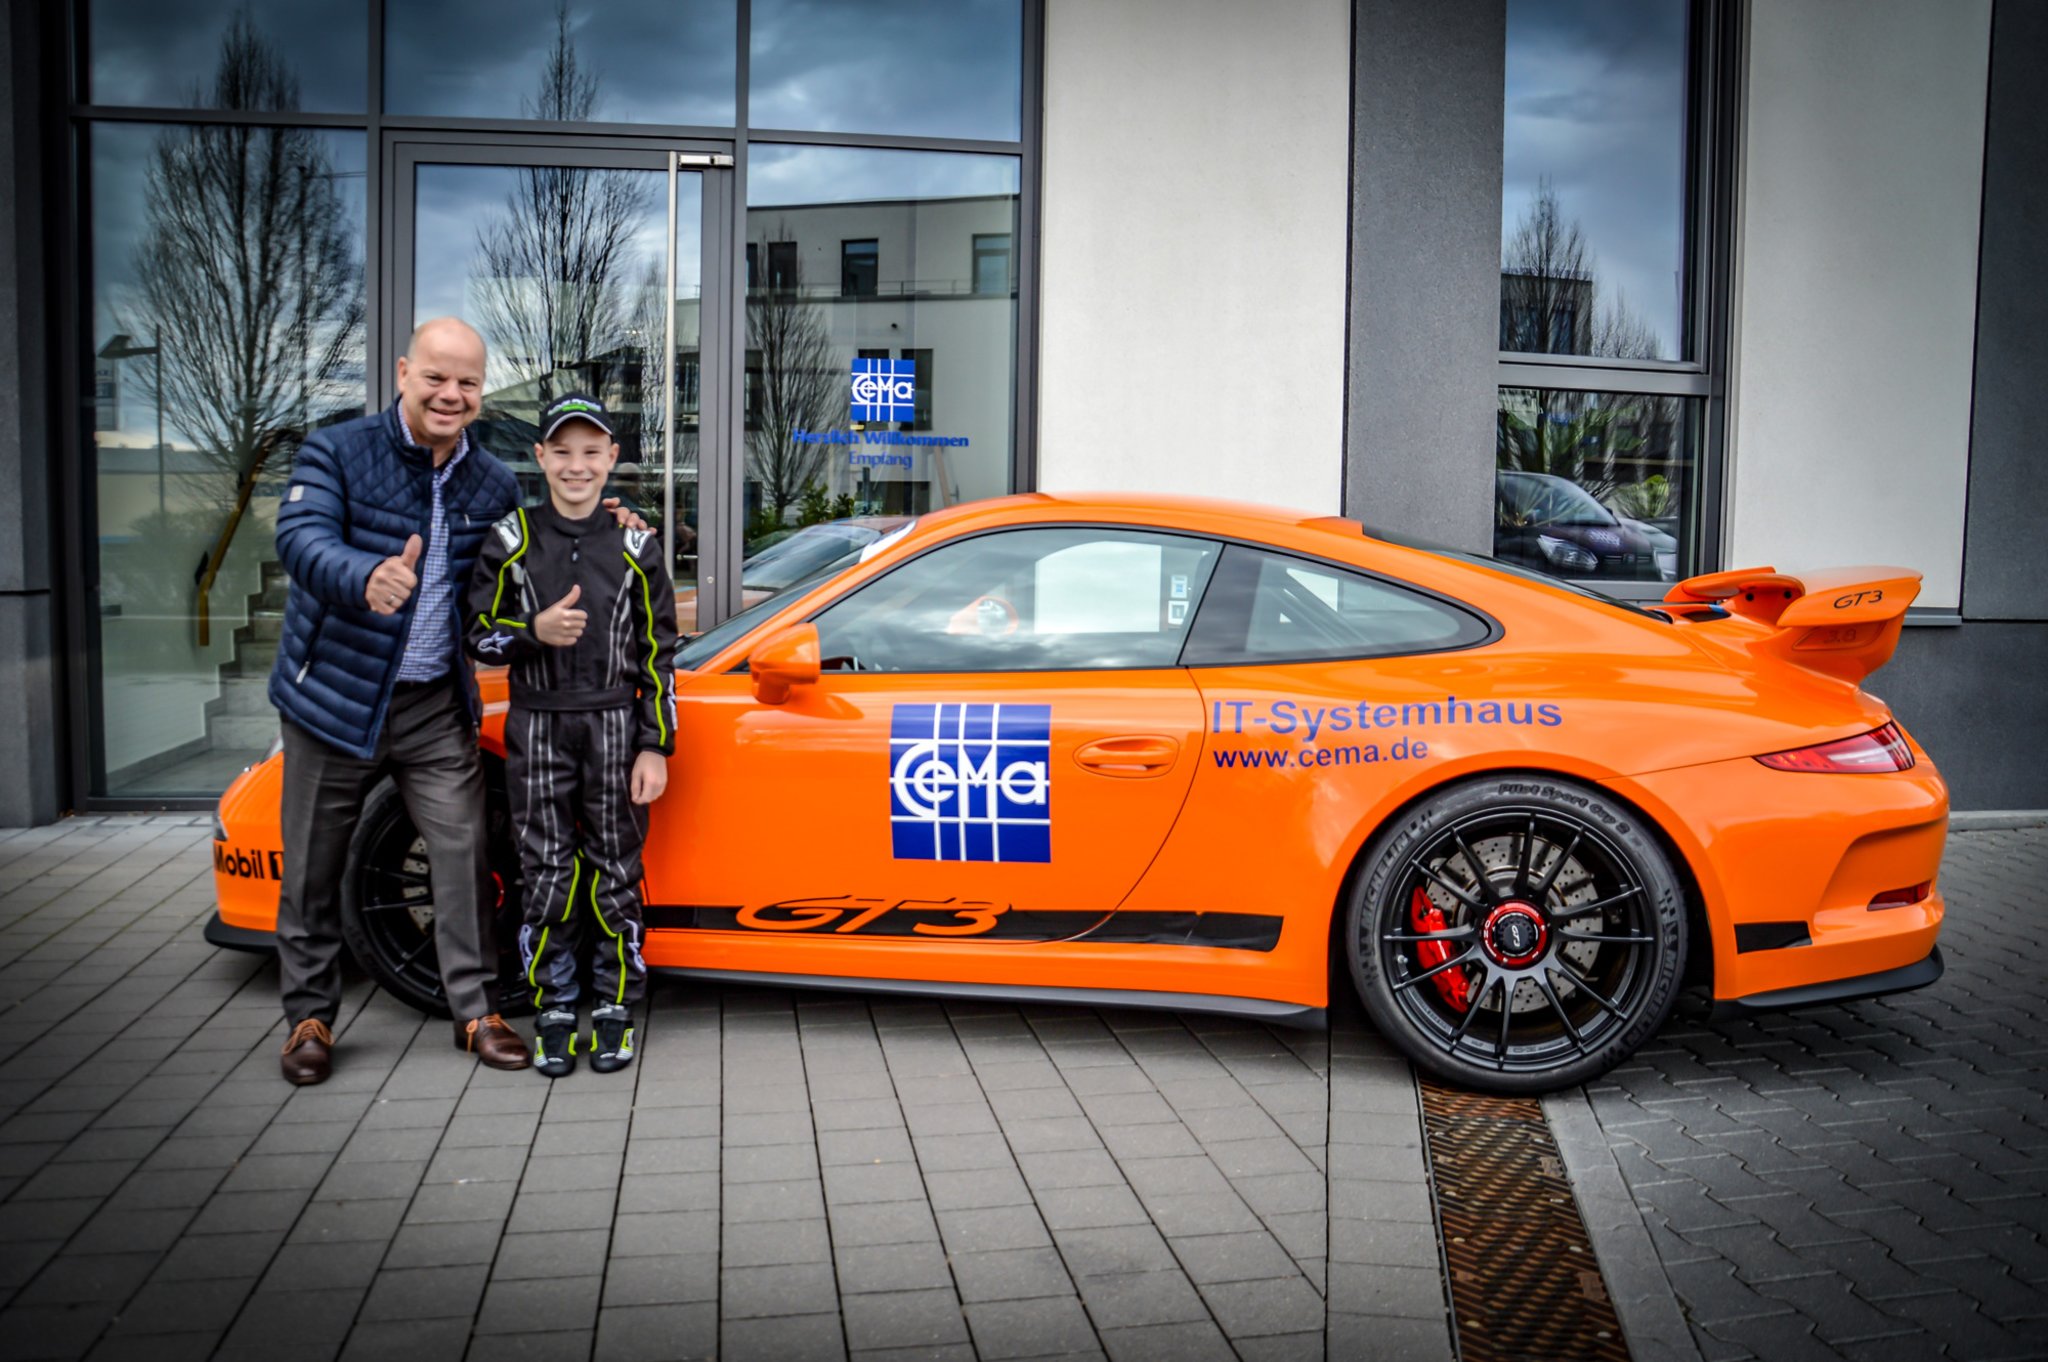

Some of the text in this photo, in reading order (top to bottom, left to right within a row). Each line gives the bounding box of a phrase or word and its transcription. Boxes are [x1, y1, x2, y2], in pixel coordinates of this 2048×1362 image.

[792, 428, 969, 448] Herzlich Willkommen
[849, 451, 913, 470] Empfang
[1833, 589, 1883, 609] GT3
[1212, 696, 1563, 742] IT-Systemhaus
[1213, 736, 1429, 769] www.cema.de
[1498, 783, 1540, 796] Pilot
[1540, 785, 1589, 808] Sport
[1589, 803, 1617, 825] Cup
[1358, 829, 1416, 928] MICHELIN
[736, 895, 1012, 937] GT3
[1621, 949, 1678, 1047] MICHELIN
